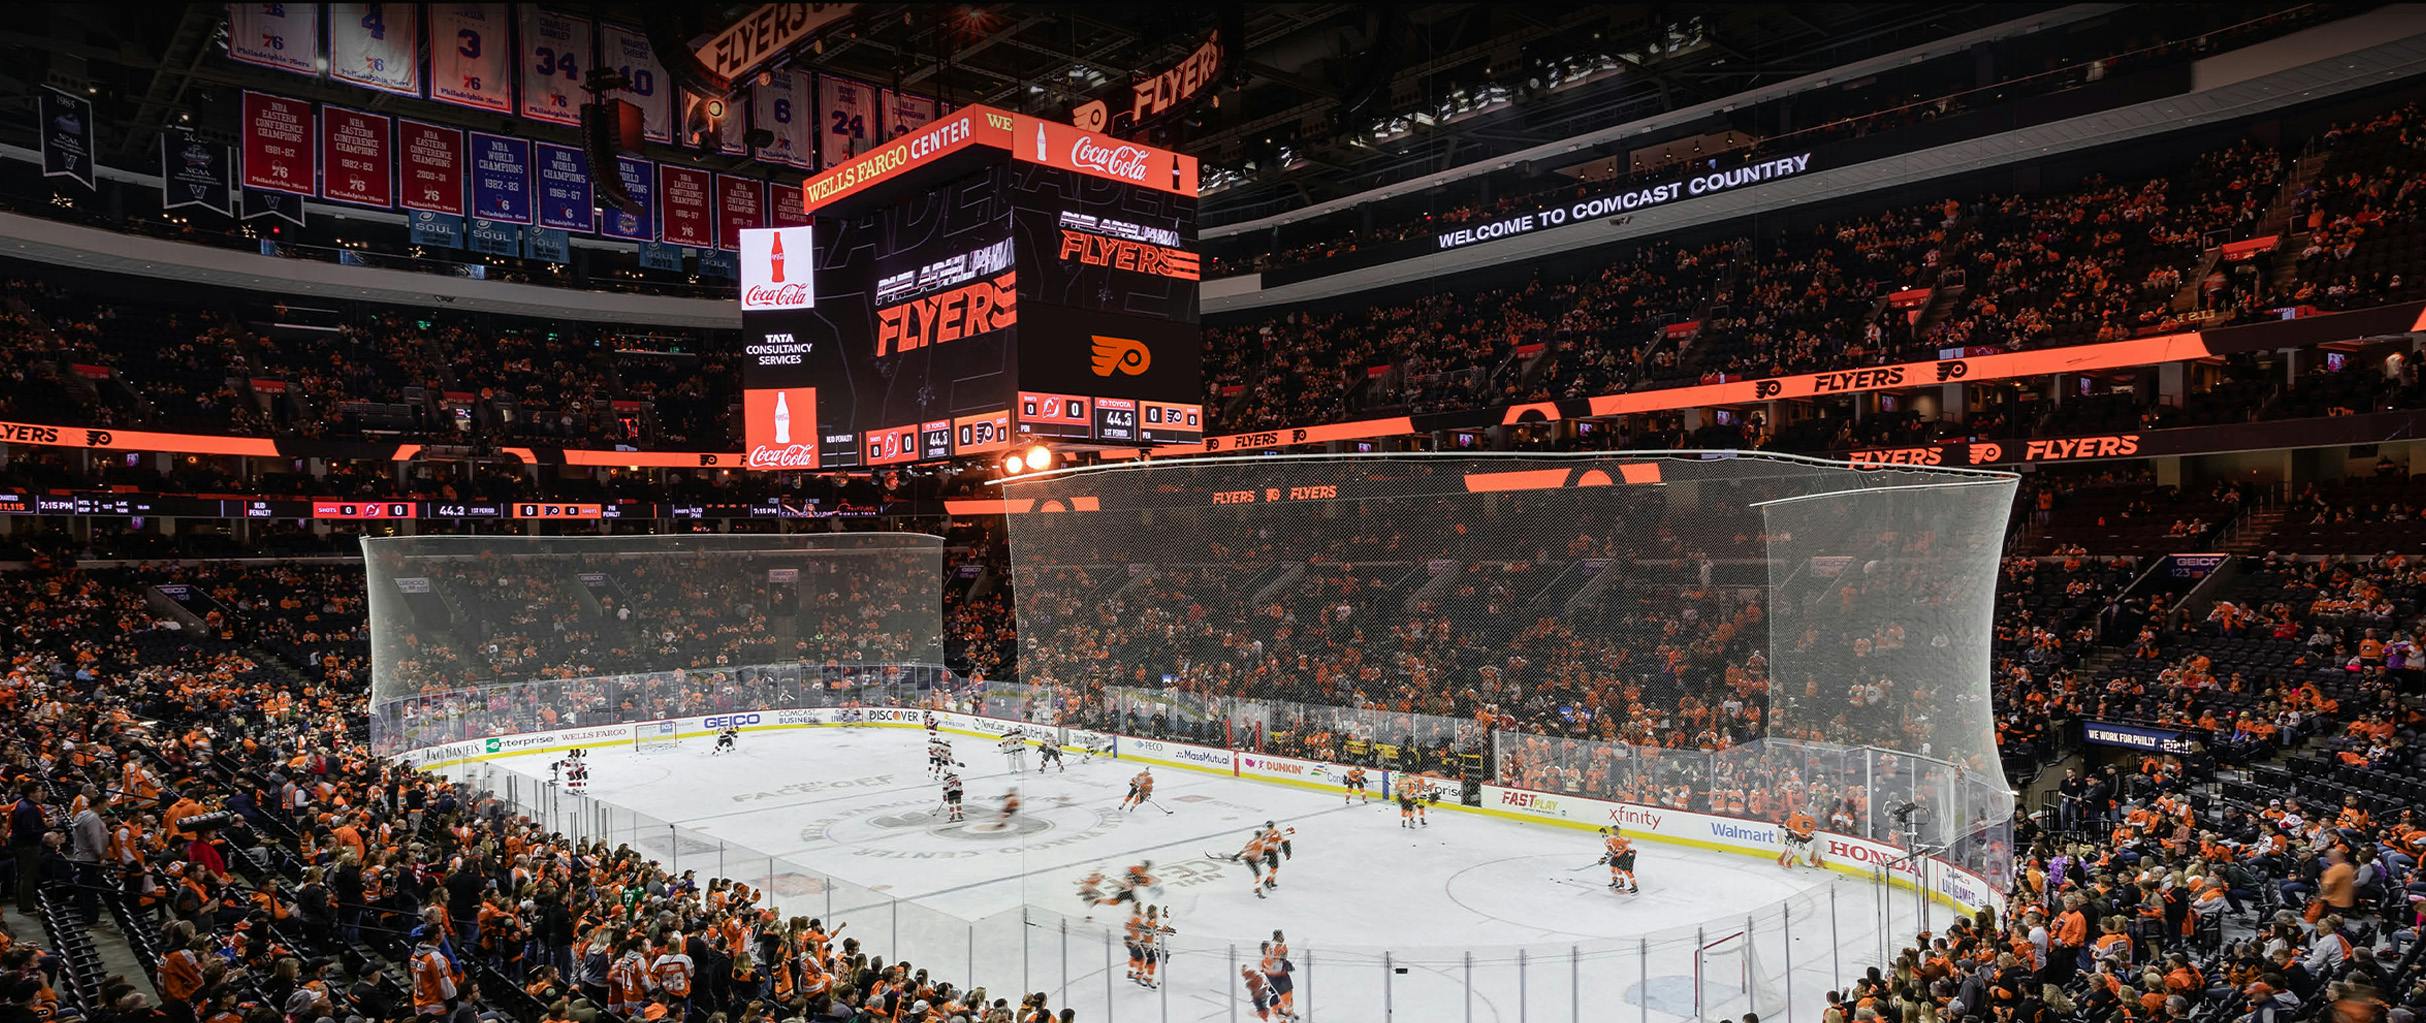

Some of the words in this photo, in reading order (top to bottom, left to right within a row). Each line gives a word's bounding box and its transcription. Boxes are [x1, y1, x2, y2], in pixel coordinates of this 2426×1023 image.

[361, 13, 385, 40] 4
[262, 33, 284, 50] 76
[458, 28, 481, 59] 3
[715, 2, 807, 73] FLYERS
[237, 47, 287, 63] Philadelphia
[366, 56, 384, 72] 76
[535, 46, 578, 81] 34
[463, 75, 481, 91] 76
[1132, 41, 1218, 122] FLYERS
[271, 102, 288, 113] NBA
[550, 93, 568, 109] 76
[262, 110, 297, 124] EASTERN
[774, 98, 792, 124] 6
[256, 118, 304, 134] CONFERENCE
[349, 118, 365, 128] NBA
[831, 110, 864, 139] 24
[257, 128, 302, 143] CHAMPIONS
[340, 125, 374, 139] EASTERN
[423, 130, 438, 140] NBA
[333, 133, 379, 148] CONFERENCE
[415, 137, 447, 150] EASTERN
[491, 140, 509, 152] NBA
[335, 142, 378, 157] CHAMPIONS
[409, 144, 452, 161] CONFERENCE
[487, 150, 514, 163] WORLD
[555, 150, 572, 162] NBA
[411, 154, 451, 168] CHAMPIONS
[807, 168, 855, 204] WELLS
[855, 145, 908, 184] FARGO
[910, 117, 971, 160] CENTER
[1071, 135, 1149, 182] Coca-Cola
[272, 165, 288, 178] 76
[478, 159, 524, 175] CHAMPIONS
[551, 160, 577, 173] WORLD
[619, 162, 635, 173] NBA
[543, 169, 586, 184] CHAMPIONS
[619, 172, 639, 184] ORLD
[349, 178, 366, 192] 76
[485, 178, 519, 192] 1982-83
[423, 189, 440, 201] 76
[1439, 215, 1533, 249] WELCOME
[1538, 207, 1566, 227] TO
[1571, 181, 1684, 220] COMCAST
[1688, 152, 1812, 196] COUNTRY
[415, 222, 457, 235] SOUL
[473, 229, 512, 242] SOUL
[681, 226, 694, 237] 76
[1059, 229, 1201, 281] FLYERS
[745, 282, 809, 307] Coca-Cola
[876, 270, 1017, 358] FLYERS
[765, 333, 795, 343] TATA
[746, 343, 813, 355] CONSULTANCY
[758, 354, 802, 366] SERVICES
[1814, 366, 1905, 393] FLYERS
[1027, 404, 1034, 414] 0
[1071, 402, 1079, 416] 0
[1108, 400, 1131, 408] TOYOTA
[1150, 408, 1157, 422] 0
[1189, 415, 1195, 425] 0
[963, 427, 969, 443] 0
[999, 429, 1005, 440] 0
[1234, 431, 1278, 449] FLYERS
[904, 435, 911, 451] 0
[2025, 435, 2141, 461] FLYERS
[749, 443, 815, 467] Coca-Cola
[873, 446, 879, 456] 0
[1848, 446, 1944, 470] FLYERS
[1213, 490, 1255, 505] FLYERS
[1289, 485, 1337, 501] FLYERS
[40, 501, 59, 510] 7:15
[59, 501, 73, 510] PM
[345, 506, 352, 514] 0
[394, 505, 403, 516] 0
[526, 505, 533, 515] 0
[2176, 557, 2221, 567] GEICO
[2171, 568, 2191, 577] 123
[778, 709, 816, 717] COMCAST
[869, 709, 919, 722] DISCOVER
[703, 714, 760, 728] GEICO
[561, 733, 595, 741] WELLS
[595, 728, 627, 738] FARGO
[2088, 729, 2098, 740] WE
[2099, 730, 2119, 743] WORK
[2119, 733, 2133, 744] FOR
[2133, 735, 2156, 747] PHILLY
[486, 735, 554, 752] enterprise
[1144, 741, 1163, 752] PECO
[1184, 749, 1230, 765] MassMutual
[1266, 761, 1304, 775] DUNKIN'
[1609, 806, 1662, 830] xfinity
[1711, 822, 1775, 844] Walmart
[1828, 840, 1923, 878] HONDA
